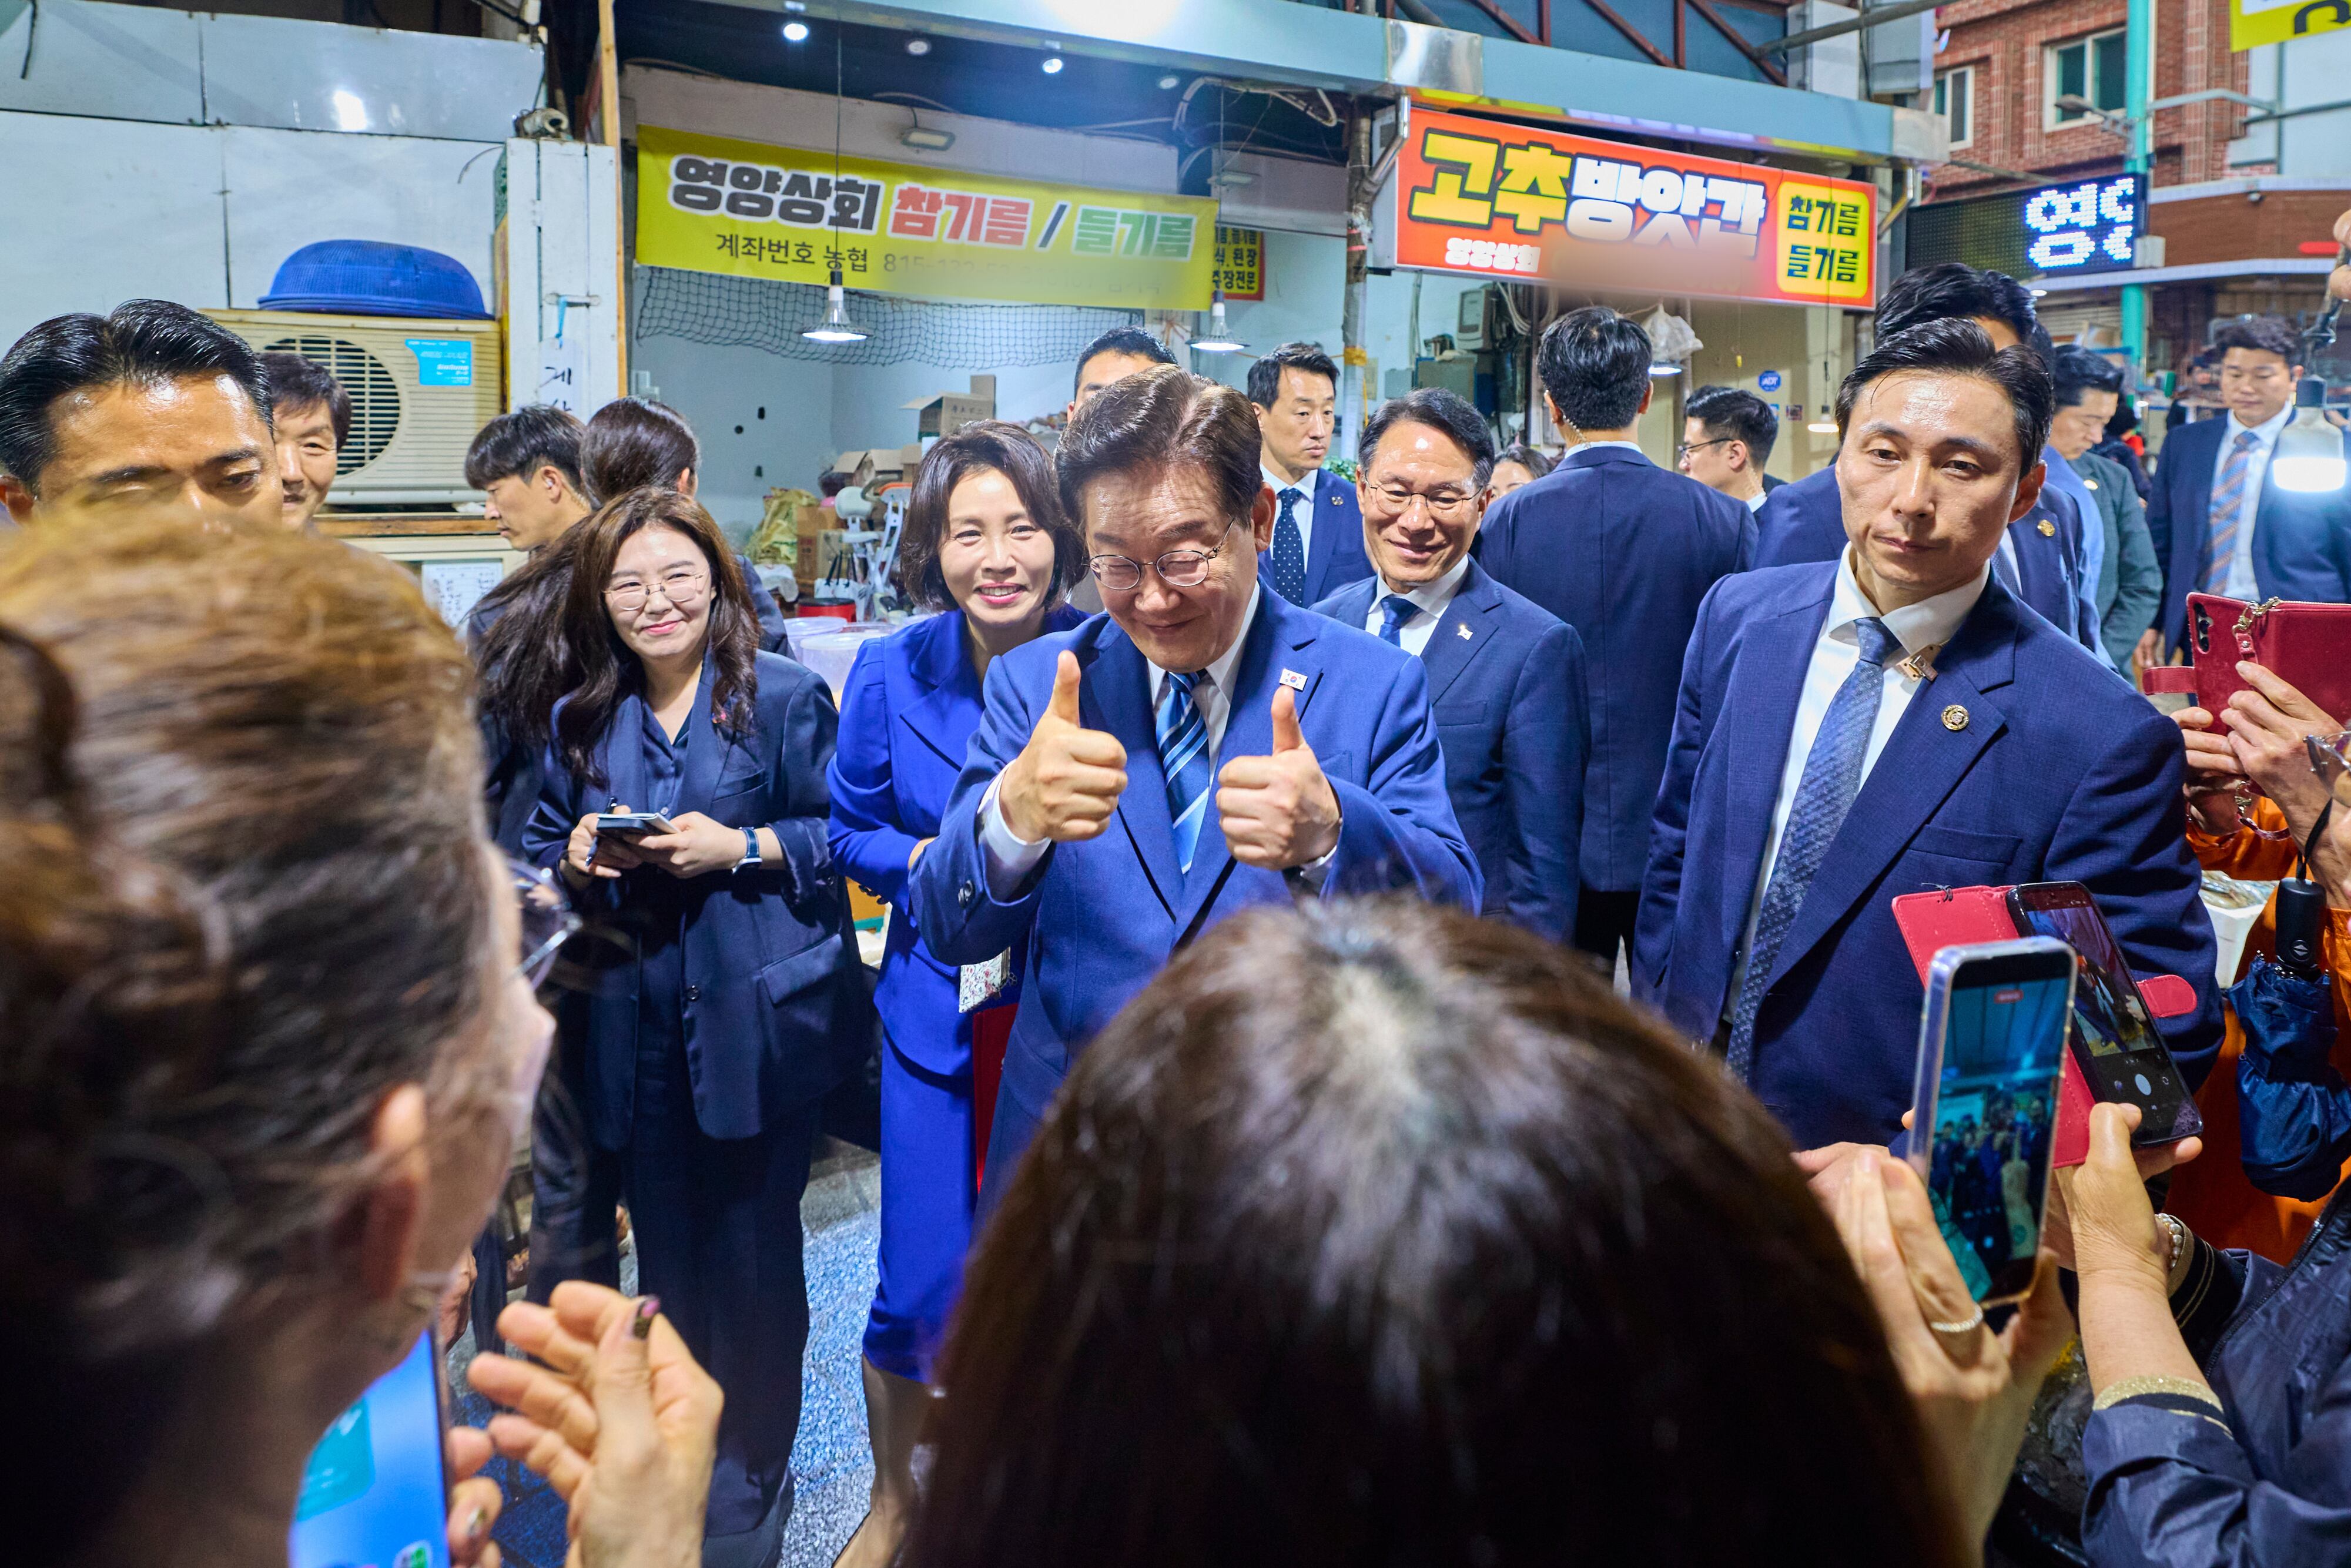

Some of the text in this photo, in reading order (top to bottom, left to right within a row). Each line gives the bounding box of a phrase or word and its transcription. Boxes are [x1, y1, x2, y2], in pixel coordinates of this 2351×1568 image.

[671, 156, 881, 232] 영양상회
[889, 185, 1033, 249] 참기름
[1073, 207, 1194, 257] 들기름
[1787, 196, 1861, 236] 참기름
[716, 233, 815, 264] 계좌번호
[823, 245, 868, 273] 농협
[1787, 244, 1859, 283] 들기름
